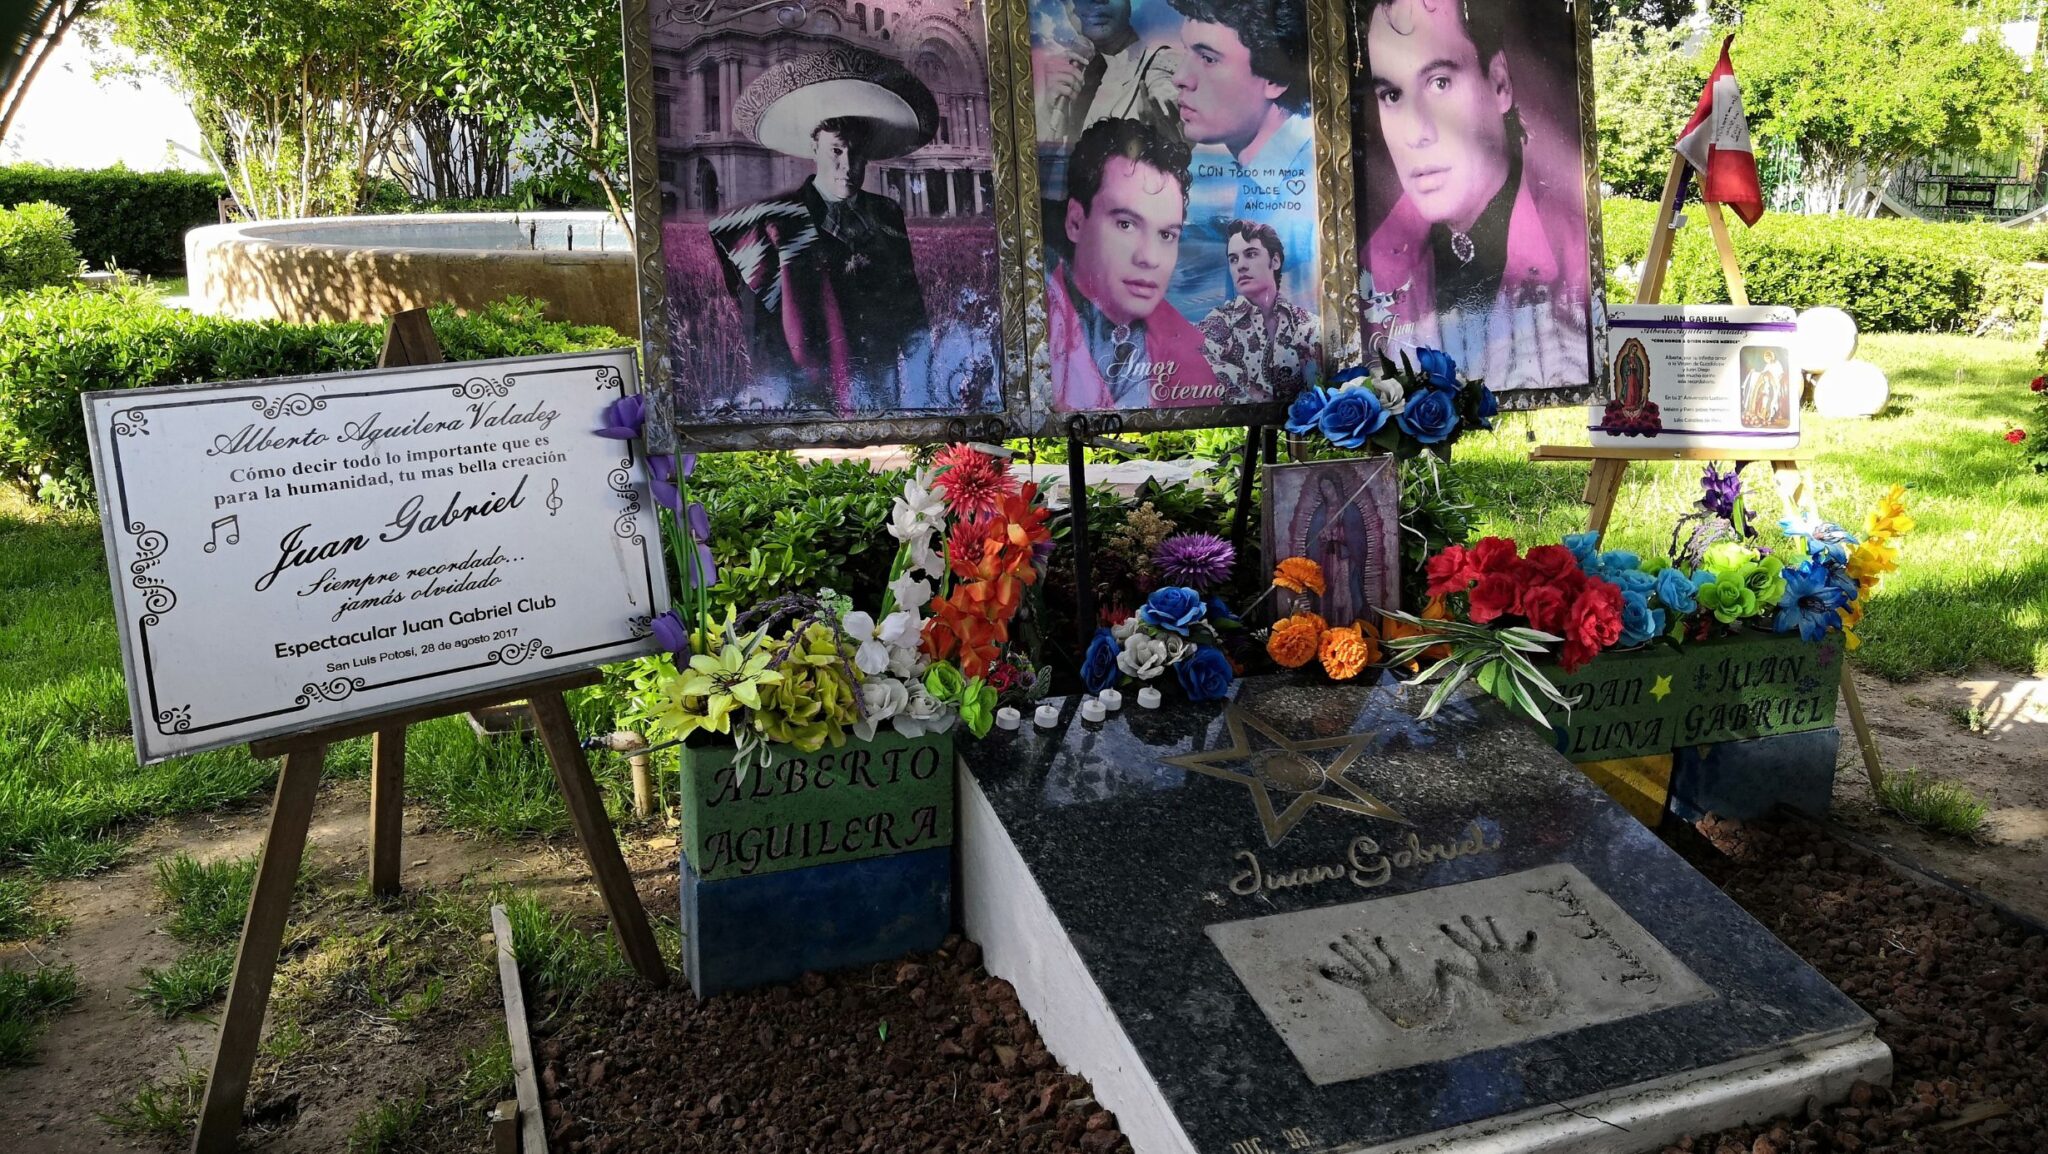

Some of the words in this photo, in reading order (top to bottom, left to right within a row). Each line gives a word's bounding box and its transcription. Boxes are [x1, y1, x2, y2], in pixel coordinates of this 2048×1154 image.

[1198, 164, 1223, 178] CON
[1229, 168, 1259, 178] TODO
[1263, 168, 1275, 177] MI
[1278, 168, 1306, 177] AMOR
[1243, 184, 1280, 195] DULCE
[1244, 201, 1302, 211] ANCHONDO
[1661, 315, 1686, 323] JUAN
[1688, 315, 1729, 323] GABRIEL
[1097, 341, 1179, 385] Amor
[1150, 372, 1227, 402] Eterno
[206, 423, 330, 457] Alberto
[337, 411, 464, 451] Aguilera
[466, 400, 561, 431] Valadez
[214, 489, 259, 509] para
[265, 486, 281, 499] la
[287, 472, 394, 497] humanidad,
[399, 470, 416, 482] tu
[421, 466, 454, 480] mas
[459, 458, 497, 475] bella
[502, 451, 567, 469] creación
[230, 467, 286, 483] Cómo
[292, 459, 338, 475] decir
[343, 454, 381, 470] todo
[386, 452, 401, 465] lo
[407, 441, 497, 463] importante
[502, 438, 530, 453] que
[535, 435, 550, 447] es
[255, 523, 370, 592] Juan
[379, 474, 529, 542] Gabriel
[297, 568, 399, 597] Siempre
[406, 545, 525, 580] recordado...
[331, 588, 406, 622] jamás
[411, 568, 502, 601] olvidado
[274, 625, 397, 658] Espectacular
[402, 617, 444, 636] Juan
[449, 601, 512, 626] Gabriel
[517, 595, 556, 613] Club
[326, 660, 350, 673] San
[353, 654, 377, 668] Luis
[380, 646, 418, 662] Potosí,
[421, 642, 436, 655] 28
[438, 639, 452, 651] de
[454, 633, 491, 649] agosto
[493, 627, 518, 642] 2017
[1716, 655, 1806, 692] JUAN
[1571, 716, 1665, 754] LUNA
[1684, 696, 1824, 742] GABRIEL
[705, 745, 941, 808] ALBERTO
[700, 805, 939, 874] AGUILERA
[1228, 850, 1345, 896] Juan
[1349, 818, 1490, 888] Gabriel
